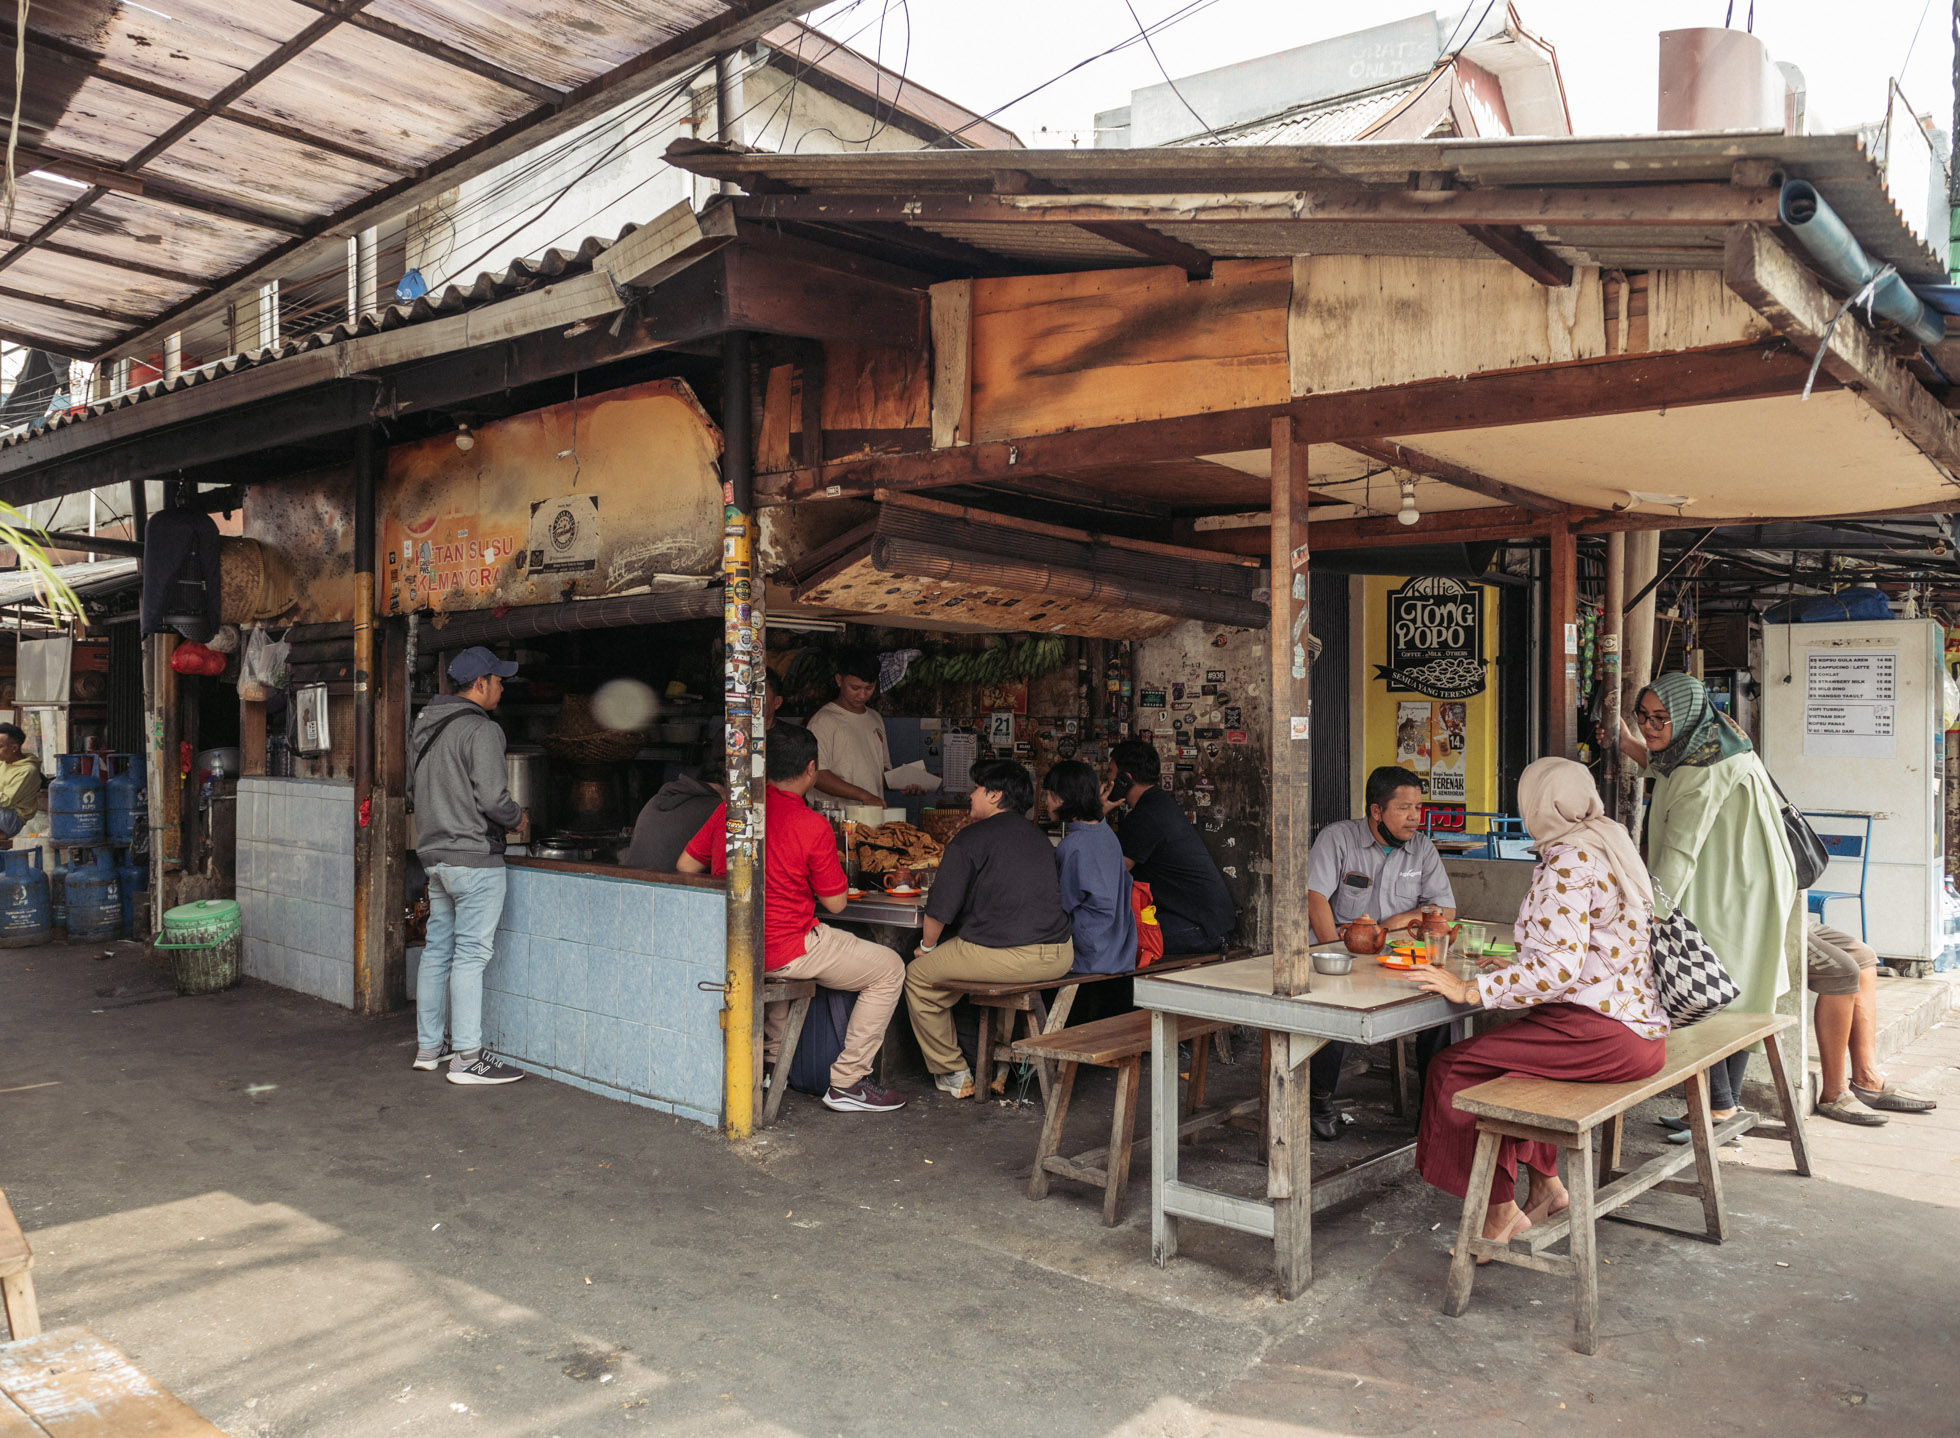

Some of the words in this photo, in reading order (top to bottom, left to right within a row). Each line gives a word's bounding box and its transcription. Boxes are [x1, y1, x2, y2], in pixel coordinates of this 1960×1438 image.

[469, 537, 513, 560] SUSU
[1392, 672, 1417, 688] SEMUA
[1418, 684, 1438, 696] YANG
[1440, 686, 1478, 698] TERENAK
[995, 718, 1010, 732] 21
[1432, 778, 1464, 790] TERENAK
